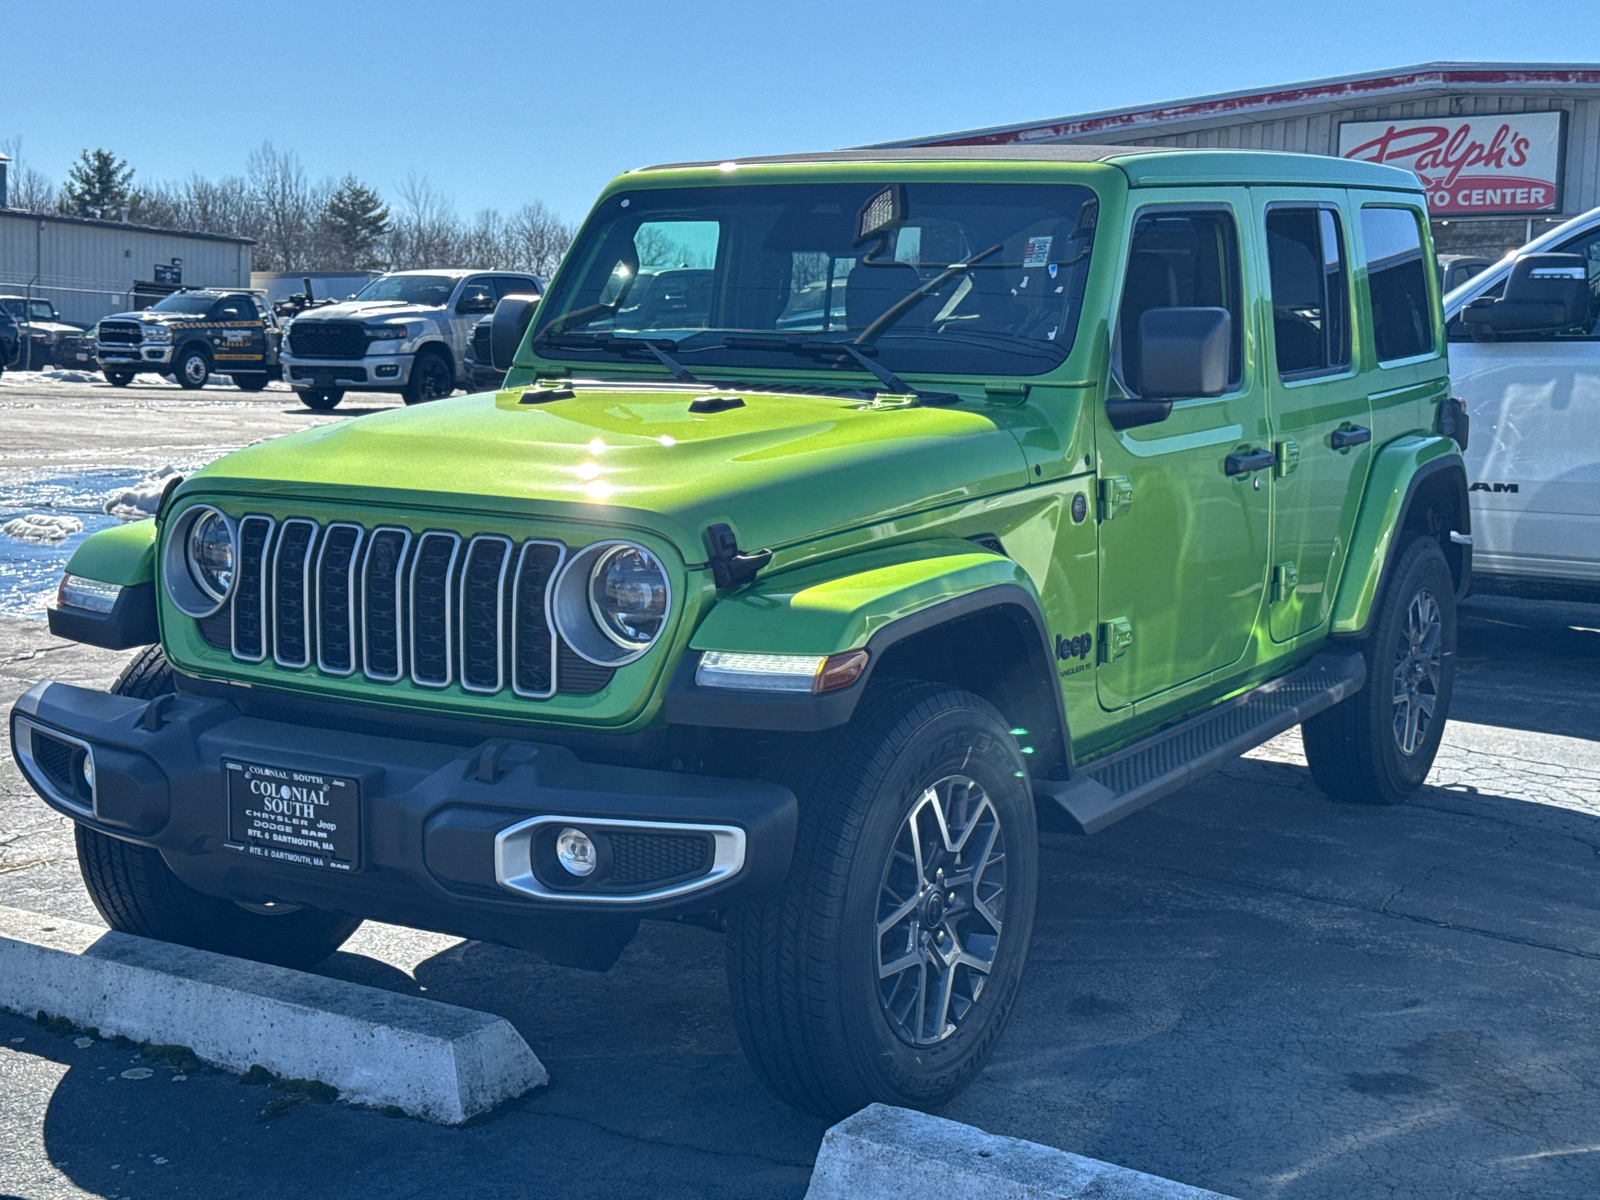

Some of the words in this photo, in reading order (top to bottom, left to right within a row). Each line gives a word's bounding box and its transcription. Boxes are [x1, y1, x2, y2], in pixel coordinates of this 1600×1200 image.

[1343, 124, 1530, 188] Ralph's
[1427, 191, 1450, 207] TO
[1457, 187, 1546, 206] CENTER
[1468, 482, 1519, 493] AM
[1055, 632, 1092, 661] Jeep
[249, 765, 290, 780] COLONIAL
[293, 773, 324, 785] SOUTH
[250, 779, 330, 806] COLONIAL
[264, 796, 316, 819] SOUTH
[245, 809, 309, 827] CHRYSLER
[316, 819, 337, 832] Jeep
[253, 819, 293, 834] DODGE
[301, 829, 328, 839] RAM
[247, 828, 264, 839] RTE.
[264, 831, 270, 840] 6
[272, 833, 321, 850] DARTMOUTH,
[322, 842, 335, 851] MA
[249, 846, 264, 857] RTE.
[264, 848, 269, 857] 6
[270, 850, 313, 867] DARTMOUTH,
[313, 857, 324, 867] MA
[330, 862, 350, 870] RAM
